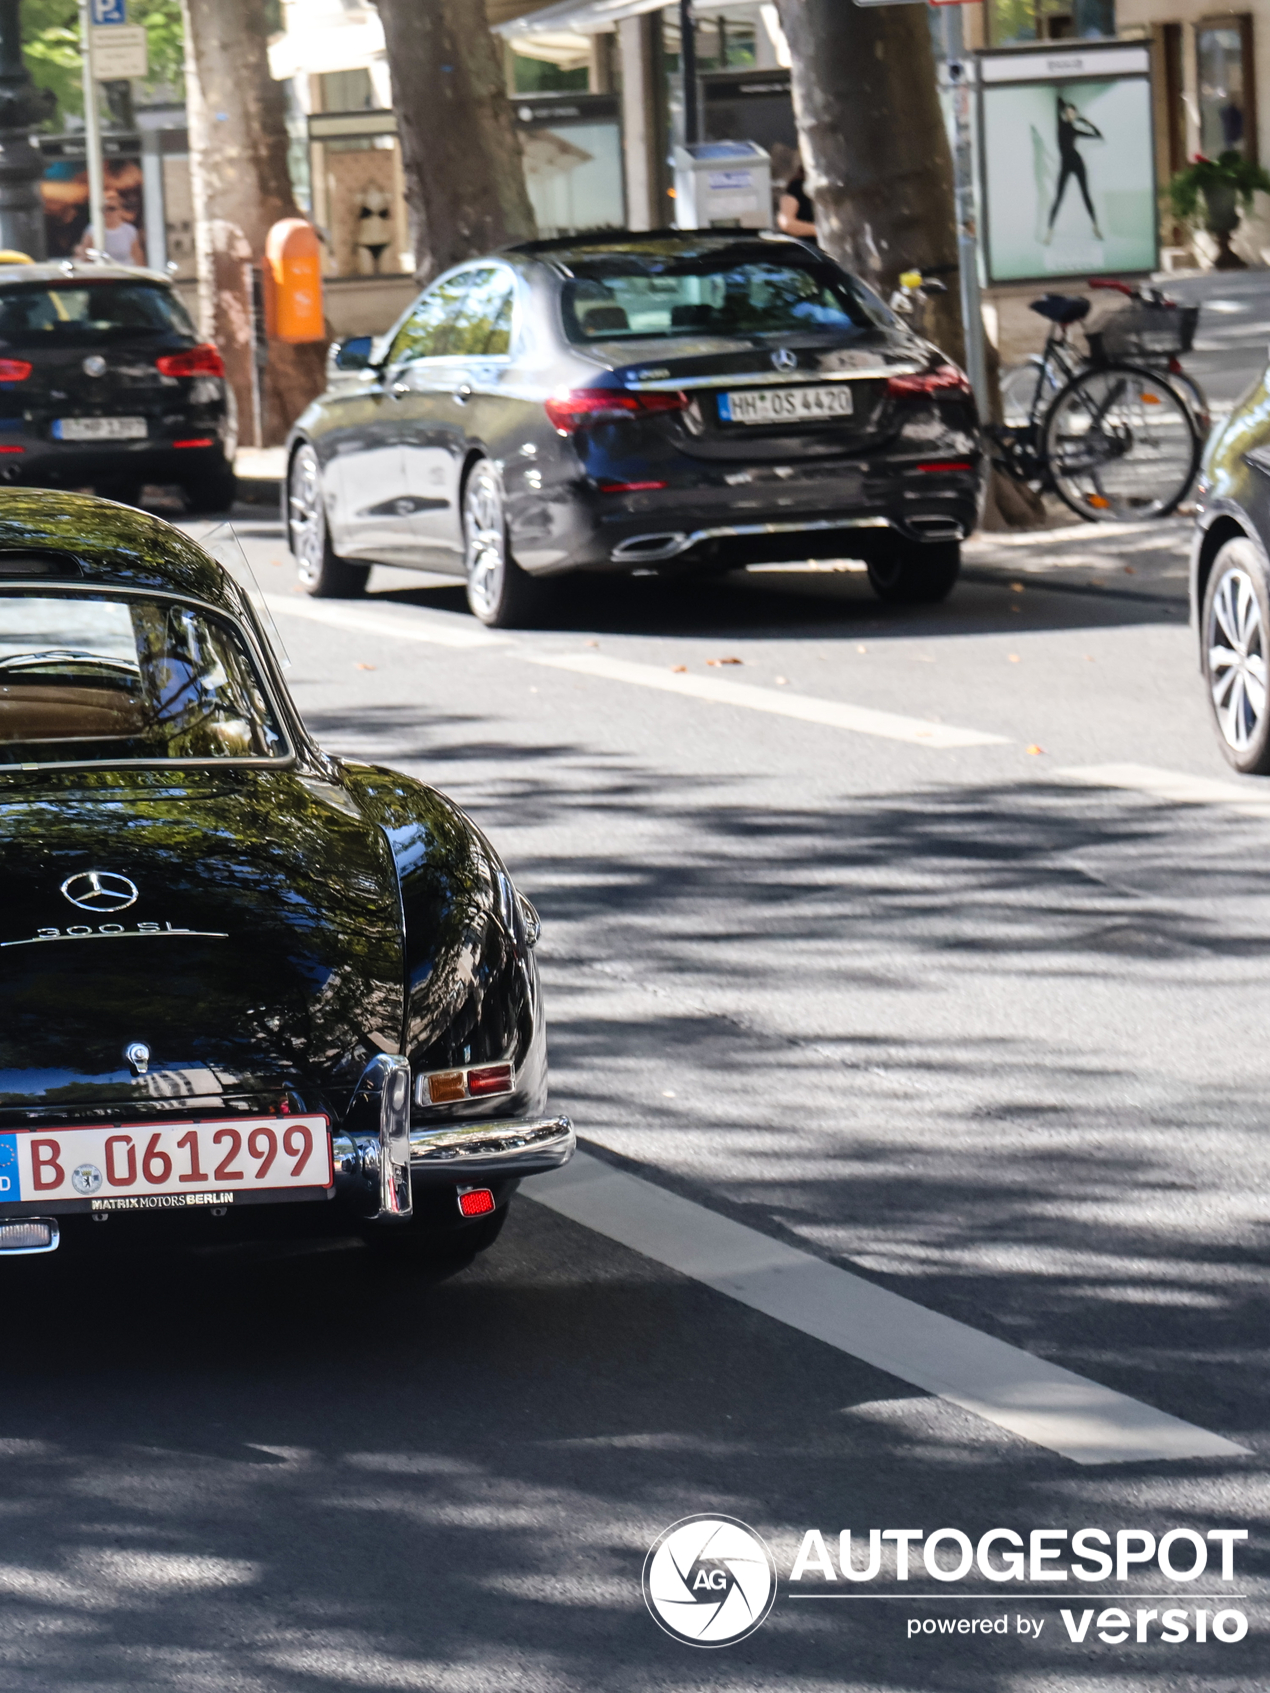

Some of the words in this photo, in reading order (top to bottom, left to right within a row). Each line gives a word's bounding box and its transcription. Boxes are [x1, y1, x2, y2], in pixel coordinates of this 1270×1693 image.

[37, 924, 125, 939] 300
[137, 921, 190, 933] SL
[31, 1139, 65, 1191] B
[105, 1125, 313, 1187] 061299
